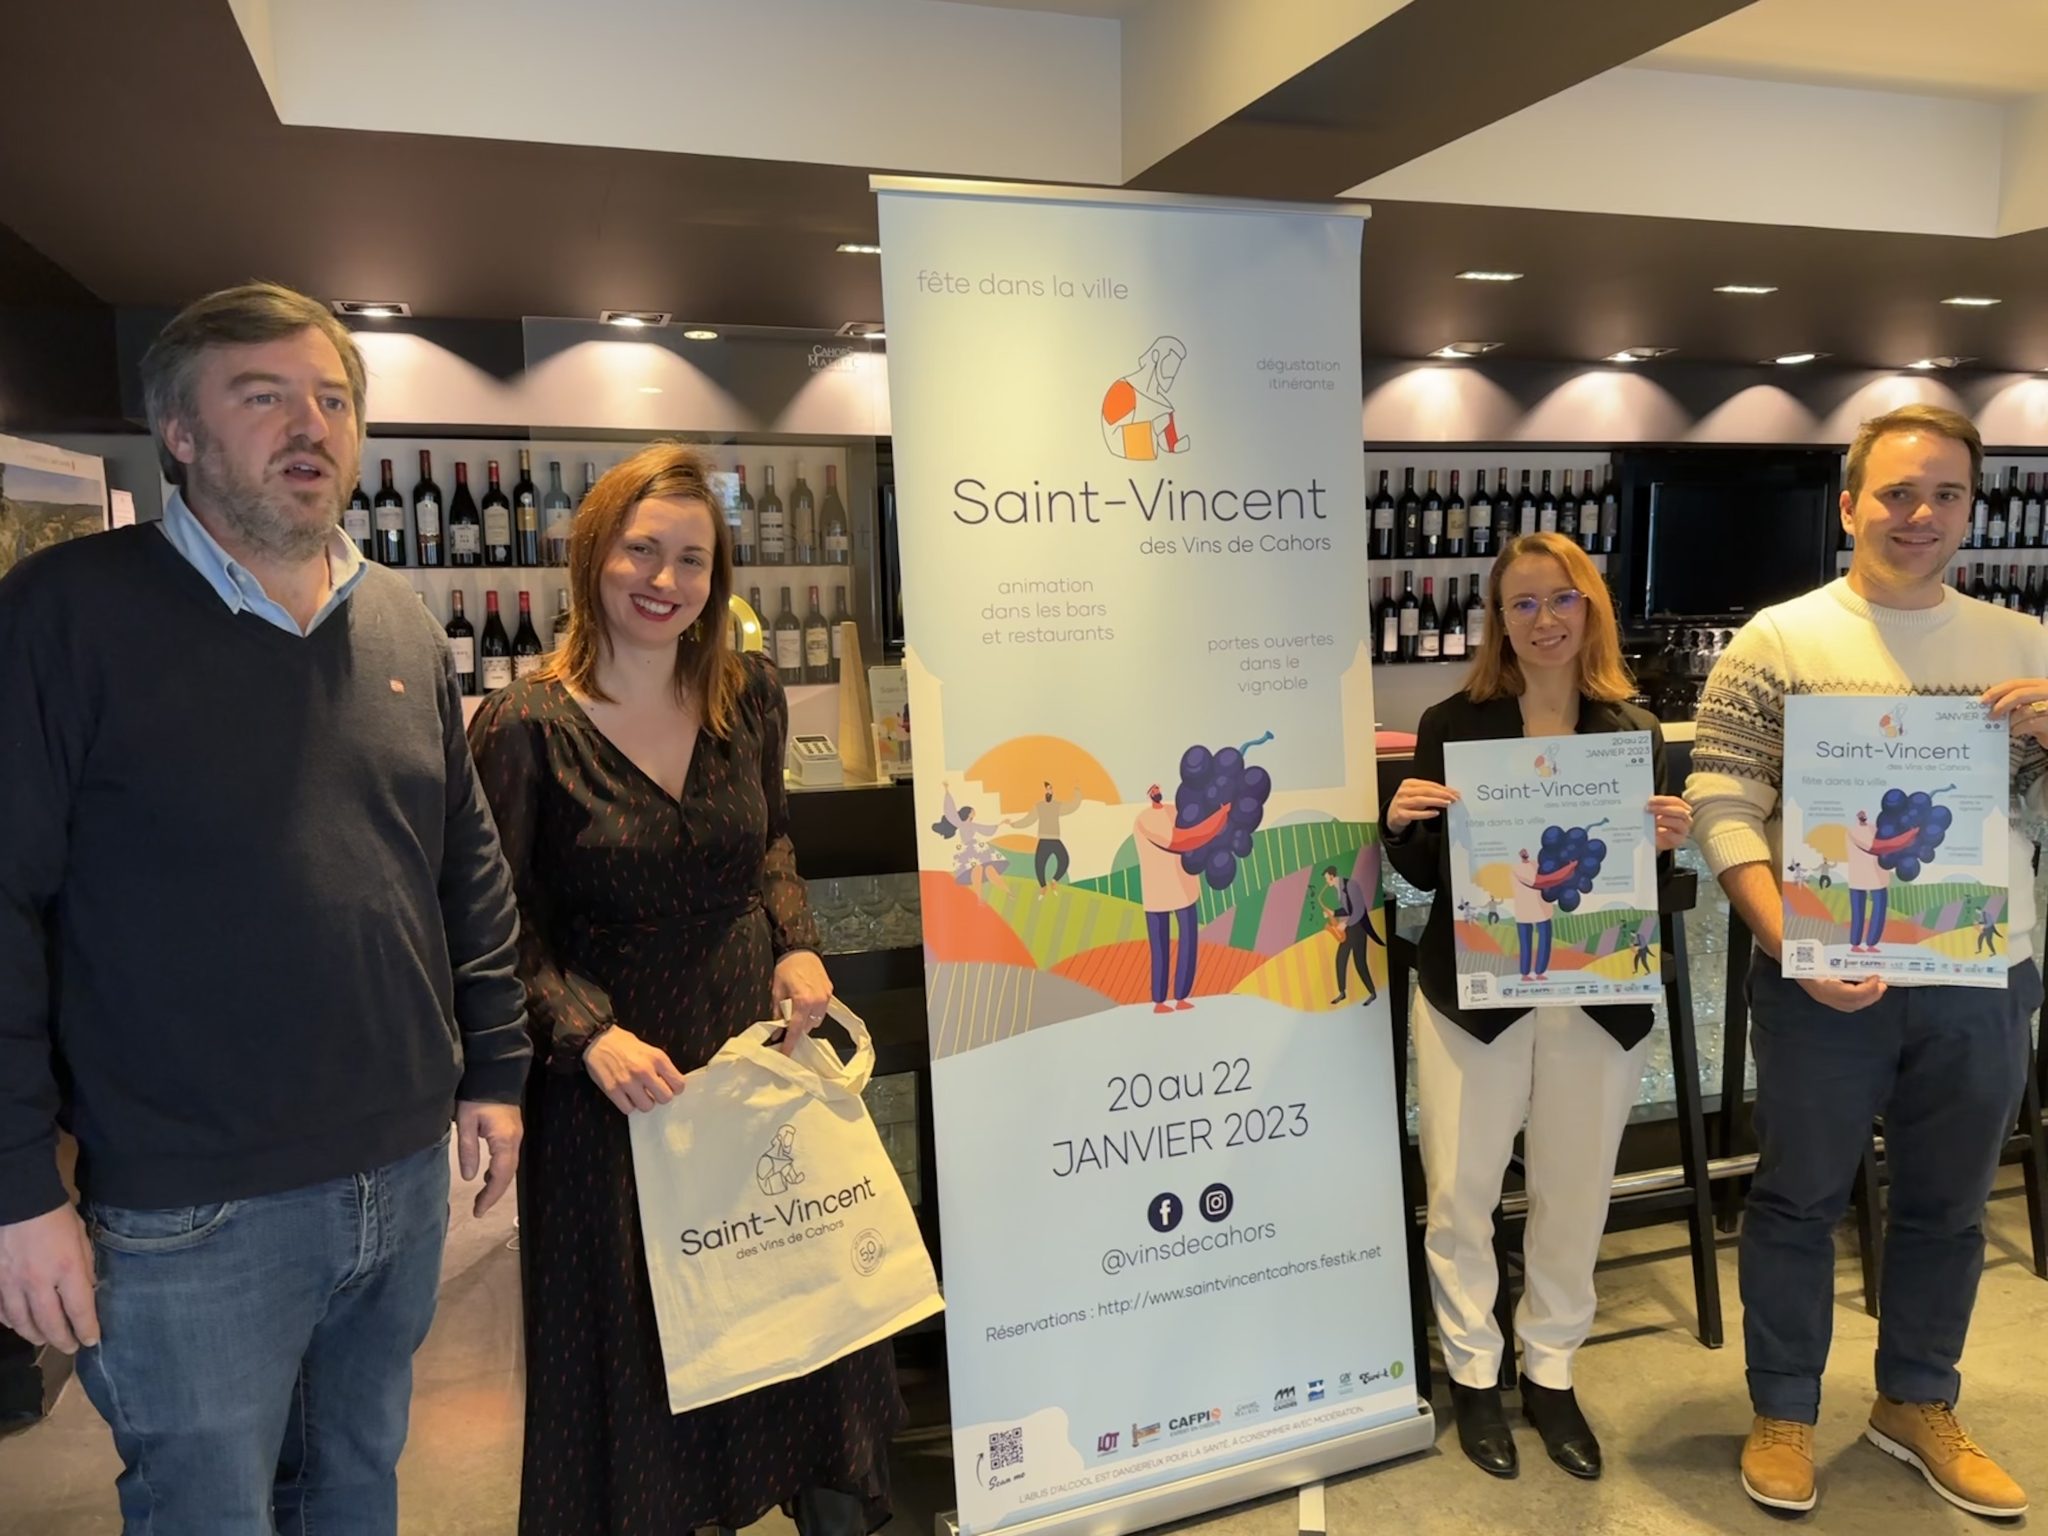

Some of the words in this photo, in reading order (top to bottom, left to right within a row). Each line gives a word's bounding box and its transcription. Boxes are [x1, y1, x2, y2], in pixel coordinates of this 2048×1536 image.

[916, 269, 971, 294] fête
[978, 272, 1045, 297] dans
[1053, 276, 1075, 298] la
[1082, 278, 1129, 300] ville
[1256, 356, 1341, 374] dégustation
[1268, 376, 1335, 390] itinérante
[953, 478, 1327, 525] Saint-Vincent
[1140, 537, 1177, 555] des
[1182, 536, 1222, 554] Vins
[1228, 535, 1254, 554] de
[1259, 534, 1331, 552] Cahors
[998, 577, 1094, 596] animation
[981, 603, 1031, 621] dans
[1036, 603, 1061, 618] les
[1066, 601, 1107, 618] bars
[981, 629, 1002, 646] et
[1008, 625, 1115, 644] restaurants
[1208, 635, 1260, 656] portes
[1264, 632, 1335, 650] ouvertes
[1240, 655, 1282, 672] dans
[1286, 655, 1300, 669] le
[1238, 676, 1308, 696] vignoble
[1935, 711, 1979, 721] JANVIER
[1585, 747, 1625, 758] JANVIER
[1816, 741, 1971, 760] Saint-Vincent
[1477, 777, 1619, 801] Saint-Vincent
[1825, 777, 1851, 786] dans
[1854, 777, 1864, 786] la
[1866, 777, 1887, 786] ville
[1487, 817, 1512, 827] dans
[1514, 816, 1524, 826] la
[1526, 816, 1545, 825] ville
[1107, 1073, 1153, 1112] 20
[1158, 1071, 1204, 1102] au
[1212, 1057, 1252, 1096] 22
[1052, 1117, 1213, 1177] JANVIER
[1224, 1102, 1309, 1148] 2023
[680, 1175, 876, 1256] Saint-Vincent
[736, 1247, 758, 1260] des
[760, 1238, 785, 1252] Vins
[787, 1232, 803, 1245] de
[804, 1218, 845, 1239] Cahors
[1101, 1219, 1277, 1276] @vinsdecahors
[986, 1307, 1087, 1342] Réservations
[1097, 1245, 1382, 1317] http://www.saintvincentcahors.festik.net
[1168, 1410, 1211, 1431] CAFPI
[1097, 1431, 1120, 1452] LOT
[1095, 1471, 1111, 1483] EST
[1165, 1451, 1189, 1463] POUR
[1190, 1448, 1202, 1457] LA
[989, 1475, 1012, 1491] Scan
